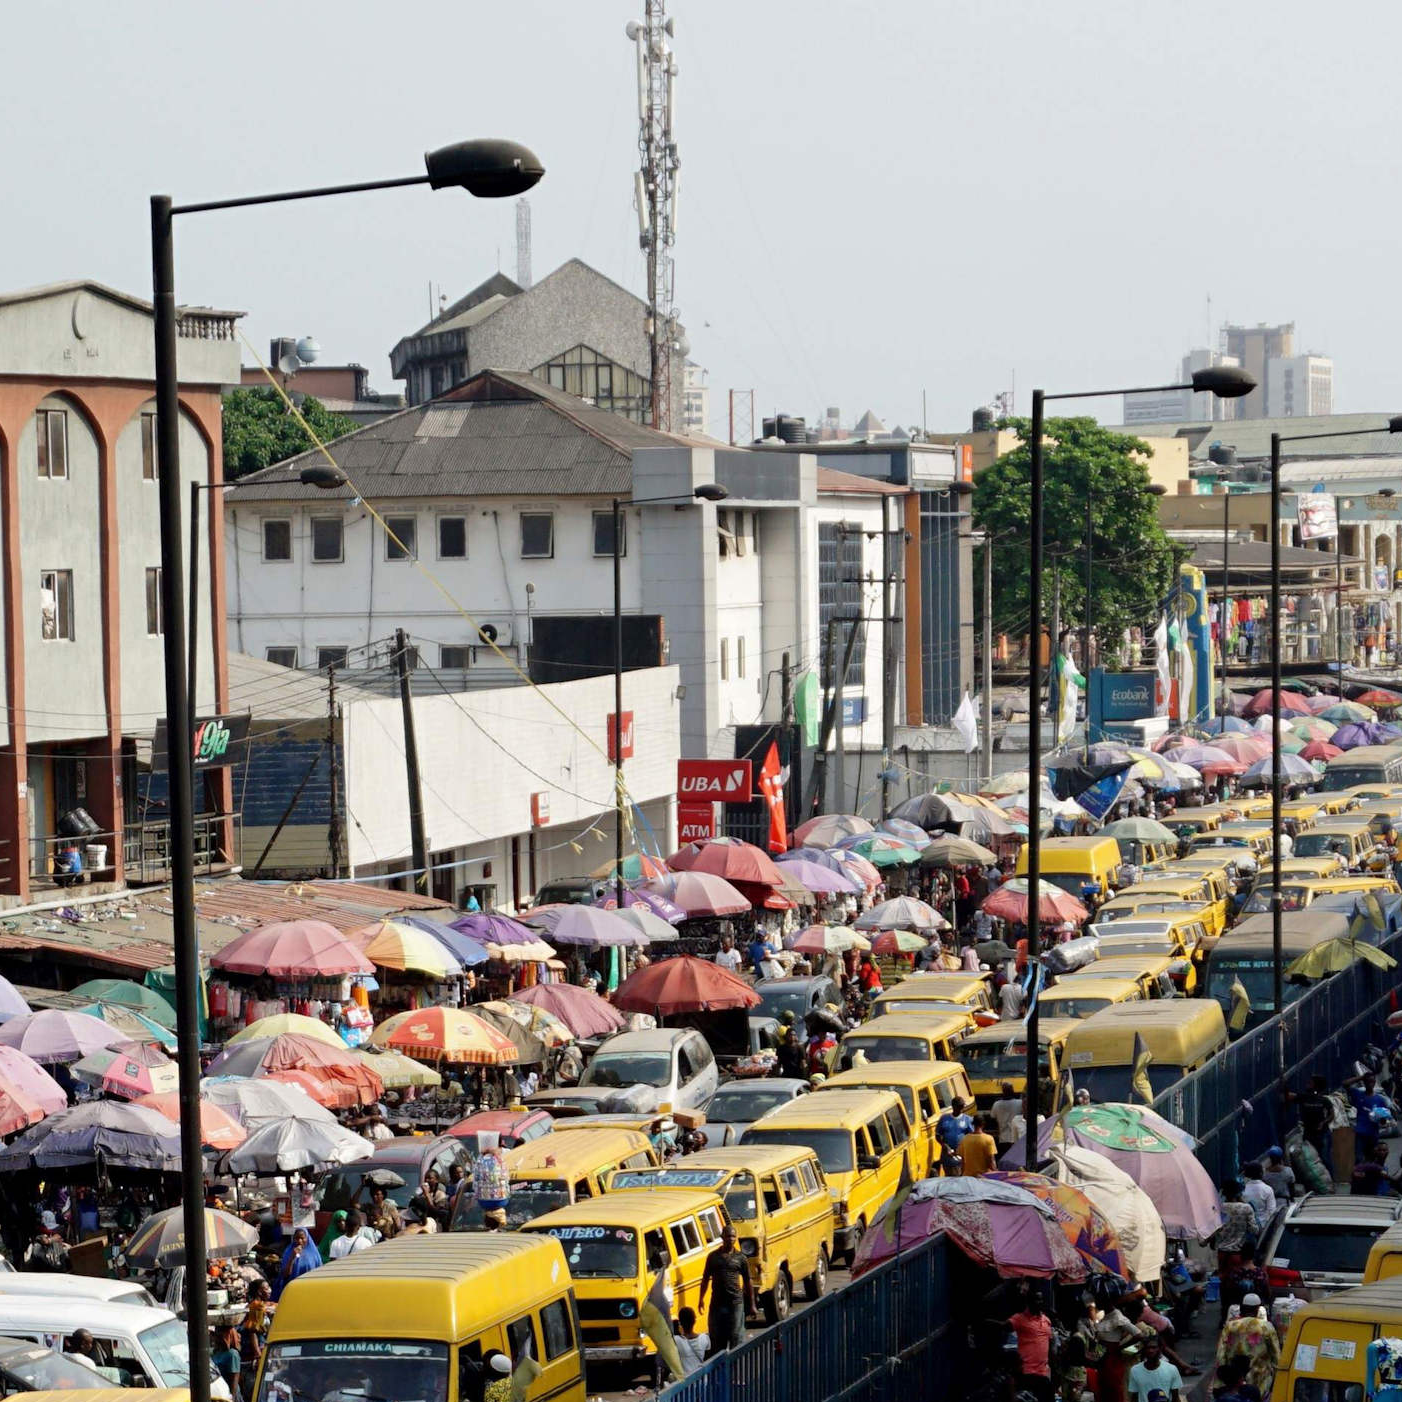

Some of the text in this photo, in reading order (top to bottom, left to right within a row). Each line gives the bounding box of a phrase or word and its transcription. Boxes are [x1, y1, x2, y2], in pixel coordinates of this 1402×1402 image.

[1112, 686, 1149, 700] Ecobank
[681, 777, 721, 792] UBA
[681, 824, 710, 837] ATM
[161, 1242, 185, 1252] GUINN
[324, 1343, 392, 1352] CHIAMAKA
